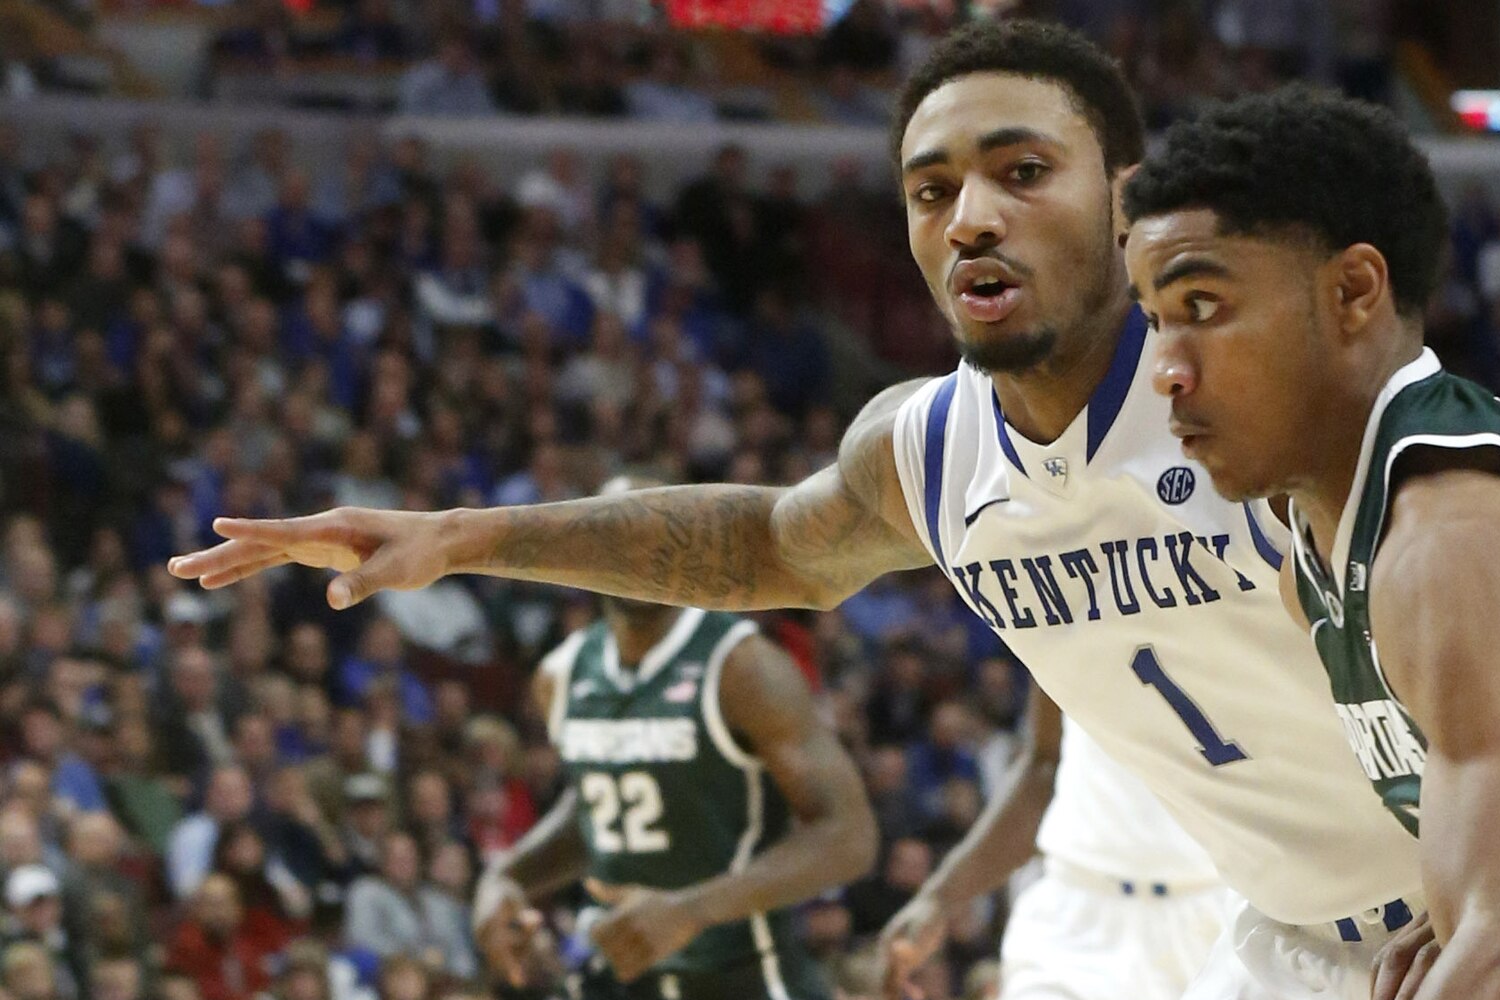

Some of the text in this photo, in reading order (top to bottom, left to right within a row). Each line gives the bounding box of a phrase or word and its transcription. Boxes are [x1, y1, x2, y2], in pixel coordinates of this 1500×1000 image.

[1160, 468, 1193, 502] SEC
[952, 531, 1257, 630] KENTUCKY
[1130, 645, 1249, 767] 1
[581, 771, 670, 854] 22
